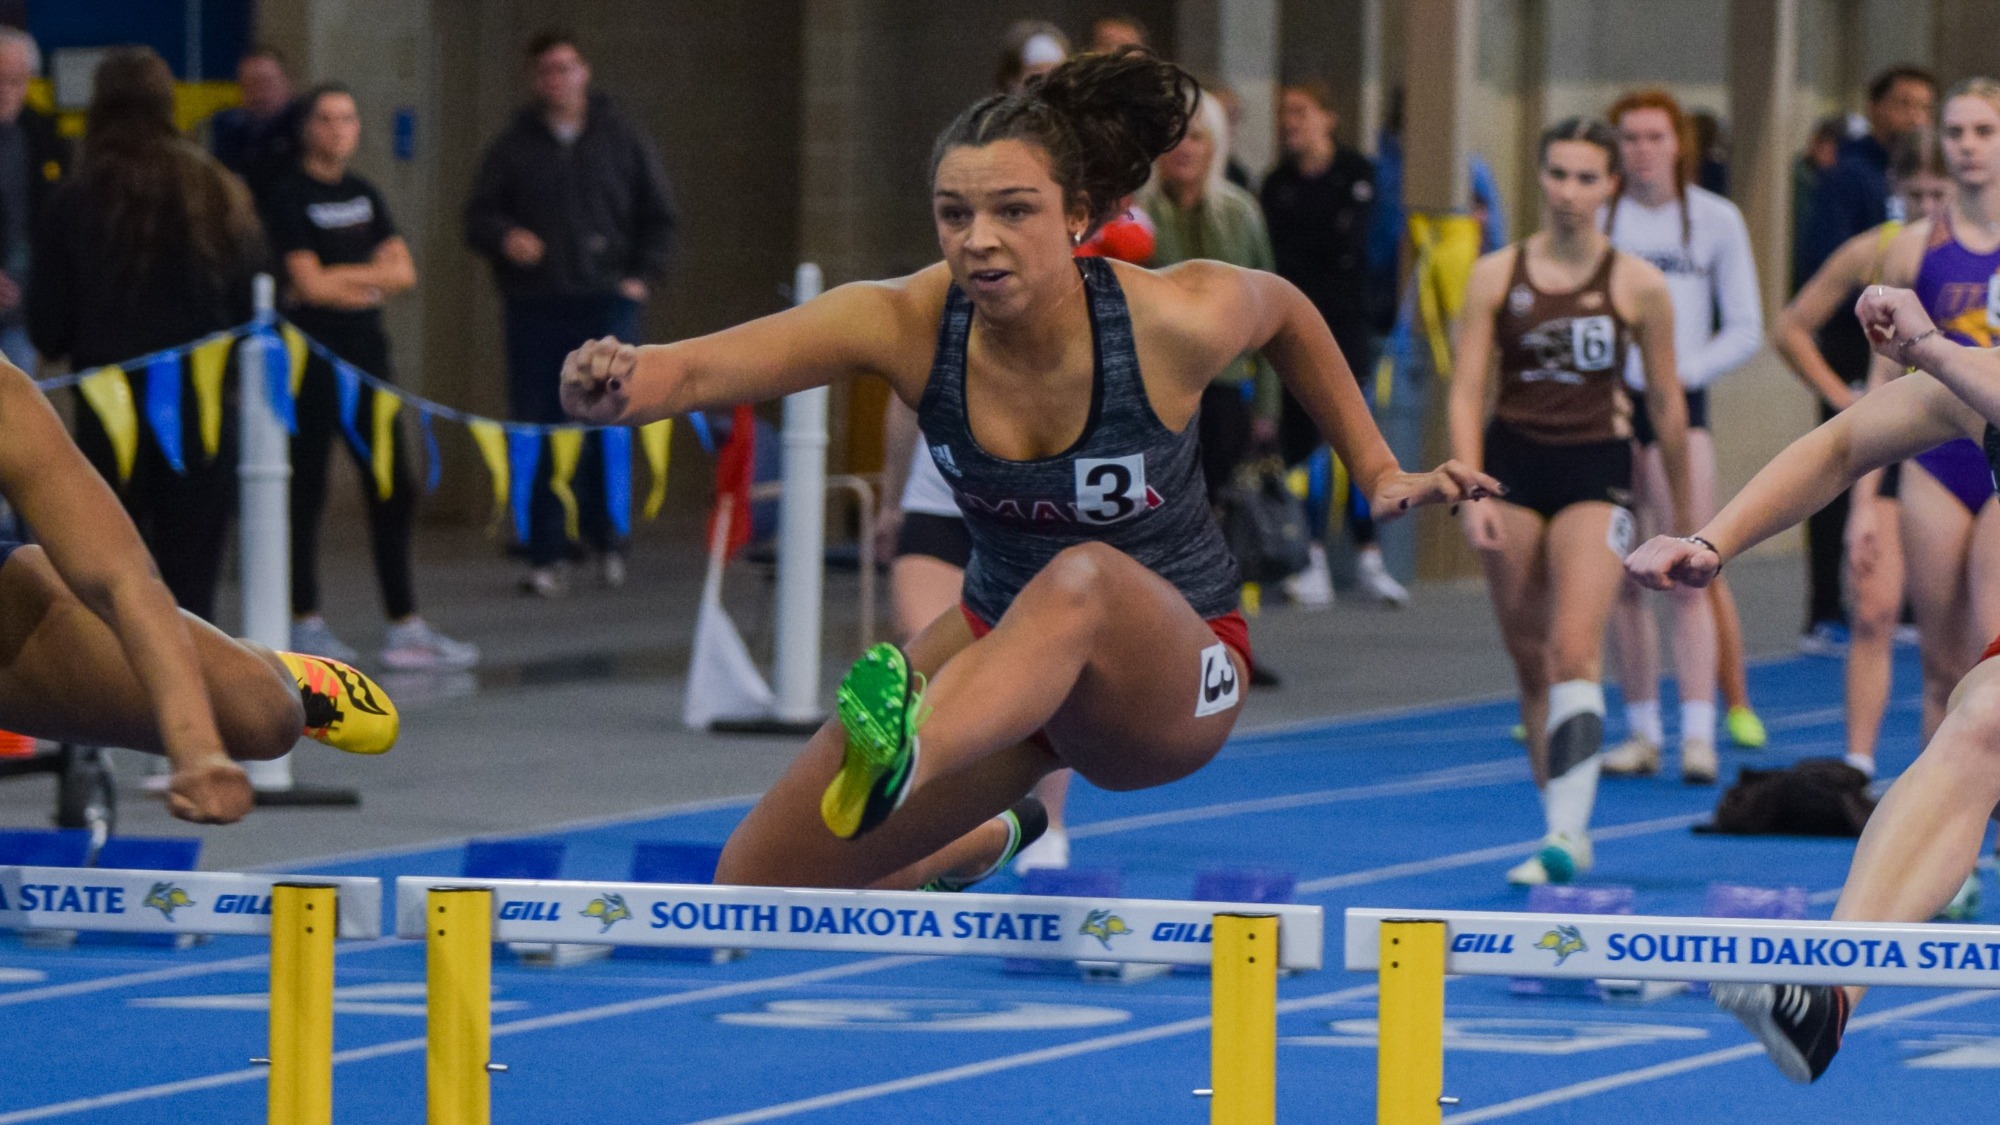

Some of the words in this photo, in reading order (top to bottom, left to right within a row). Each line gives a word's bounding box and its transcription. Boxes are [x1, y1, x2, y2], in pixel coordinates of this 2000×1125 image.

[1582, 324, 1607, 363] 6
[1084, 463, 1135, 522] 3
[1204, 651, 1235, 704] 3
[19, 884, 126, 914] STATE
[213, 894, 271, 915] GILL
[499, 900, 562, 922] GILL
[650, 900, 777, 932] SOUTH
[789, 906, 943, 938] DAKOTA
[952, 910, 1061, 942] STATE
[1152, 922, 1213, 944] GILL
[1451, 933, 1515, 954] GILL
[1606, 933, 1738, 965] SOUTH
[1749, 937, 1908, 968] DAKOTA
